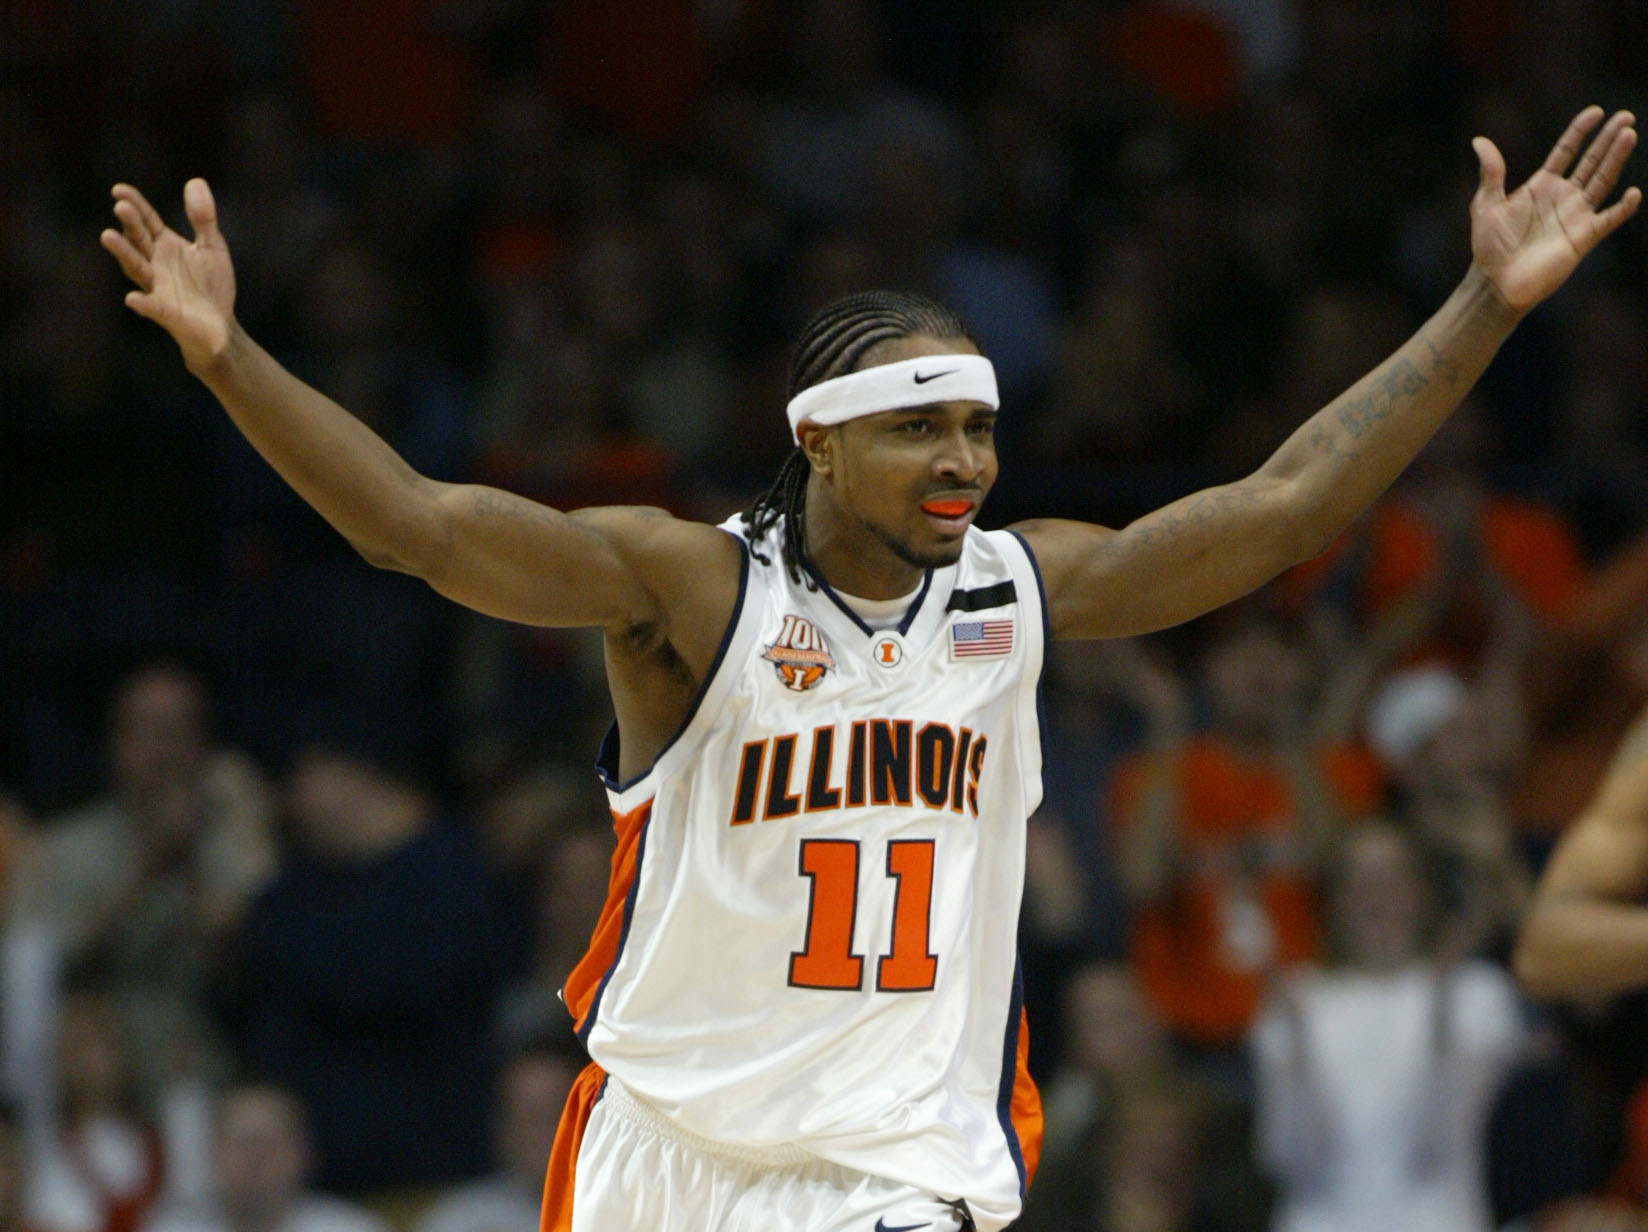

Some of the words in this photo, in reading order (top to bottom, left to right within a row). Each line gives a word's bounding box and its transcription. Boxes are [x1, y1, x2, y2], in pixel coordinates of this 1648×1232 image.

[789, 669, 806, 692] I
[881, 643, 895, 663] I
[730, 718, 988, 827] ILLINOIS
[787, 838, 938, 993] 11
